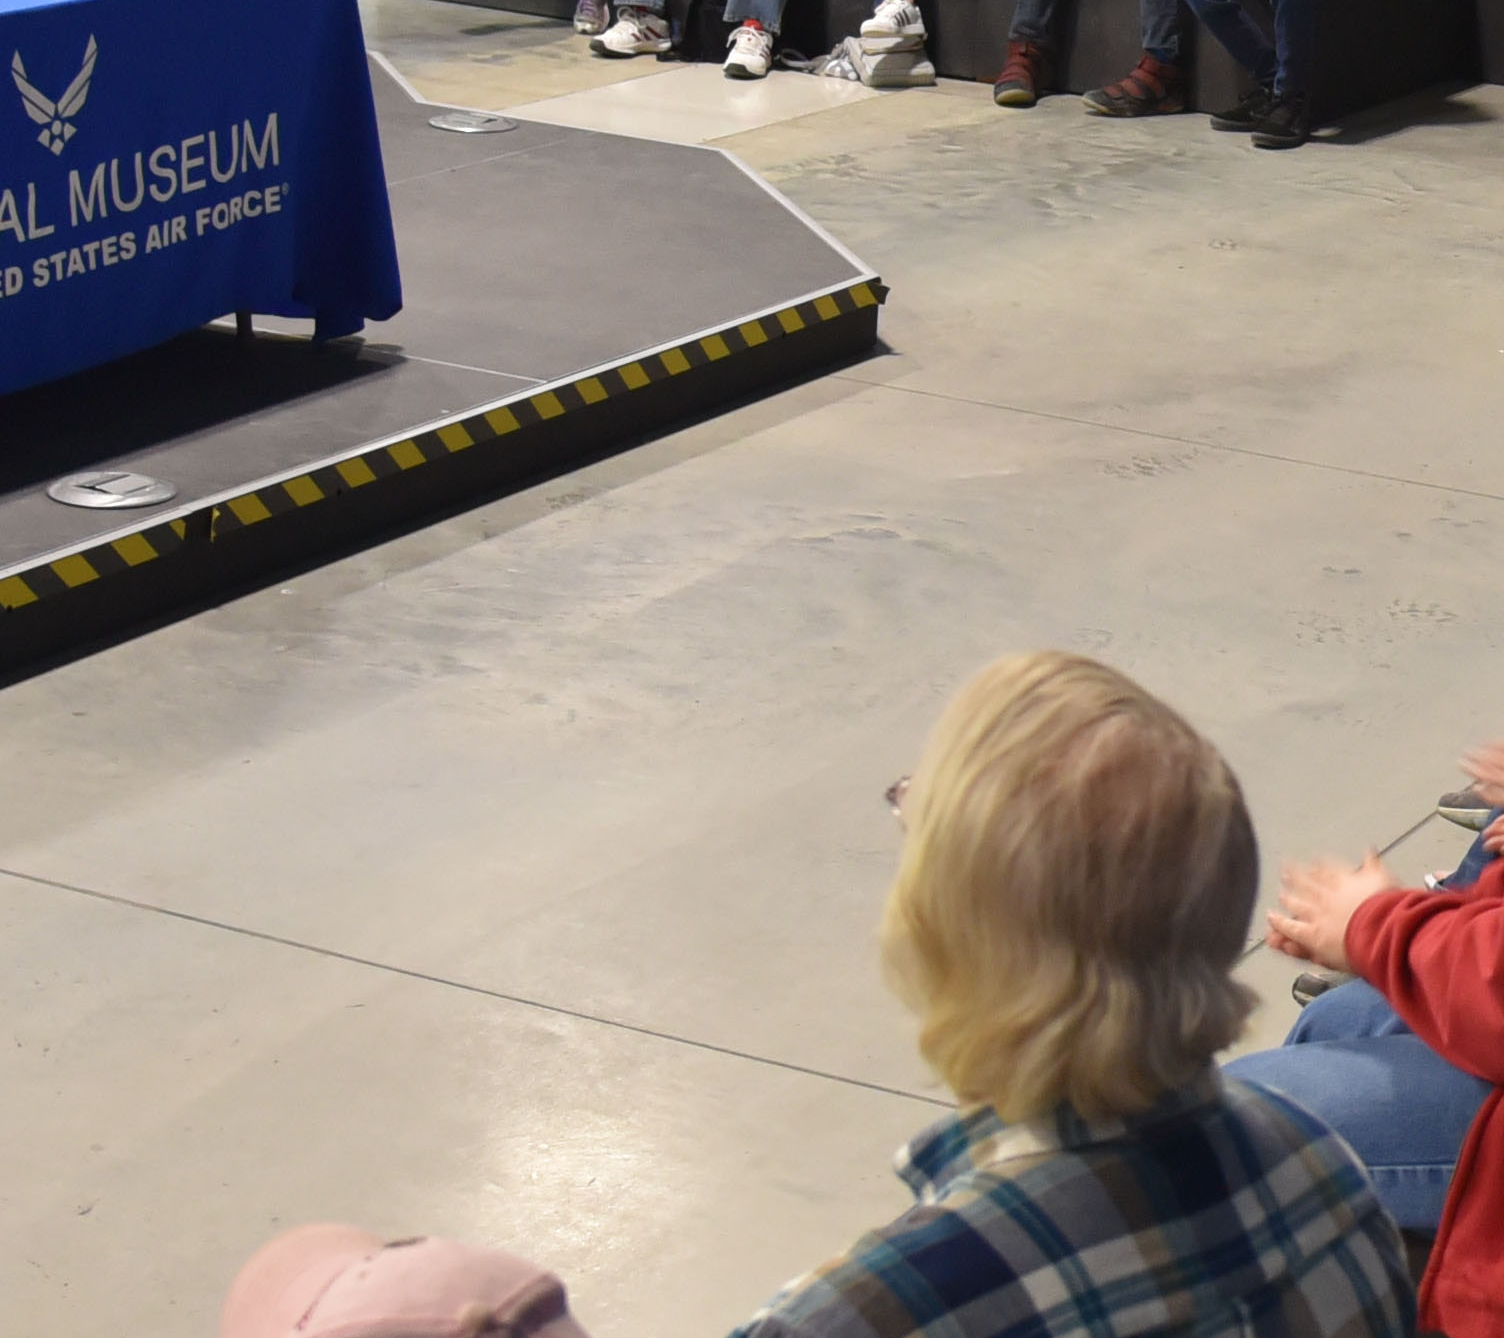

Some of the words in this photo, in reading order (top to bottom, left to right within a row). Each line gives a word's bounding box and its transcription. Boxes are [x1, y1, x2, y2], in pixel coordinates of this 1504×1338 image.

[69, 112, 280, 227] MUSEUM
[33, 232, 137, 288] STATES
[146, 215, 188, 254] AIR
